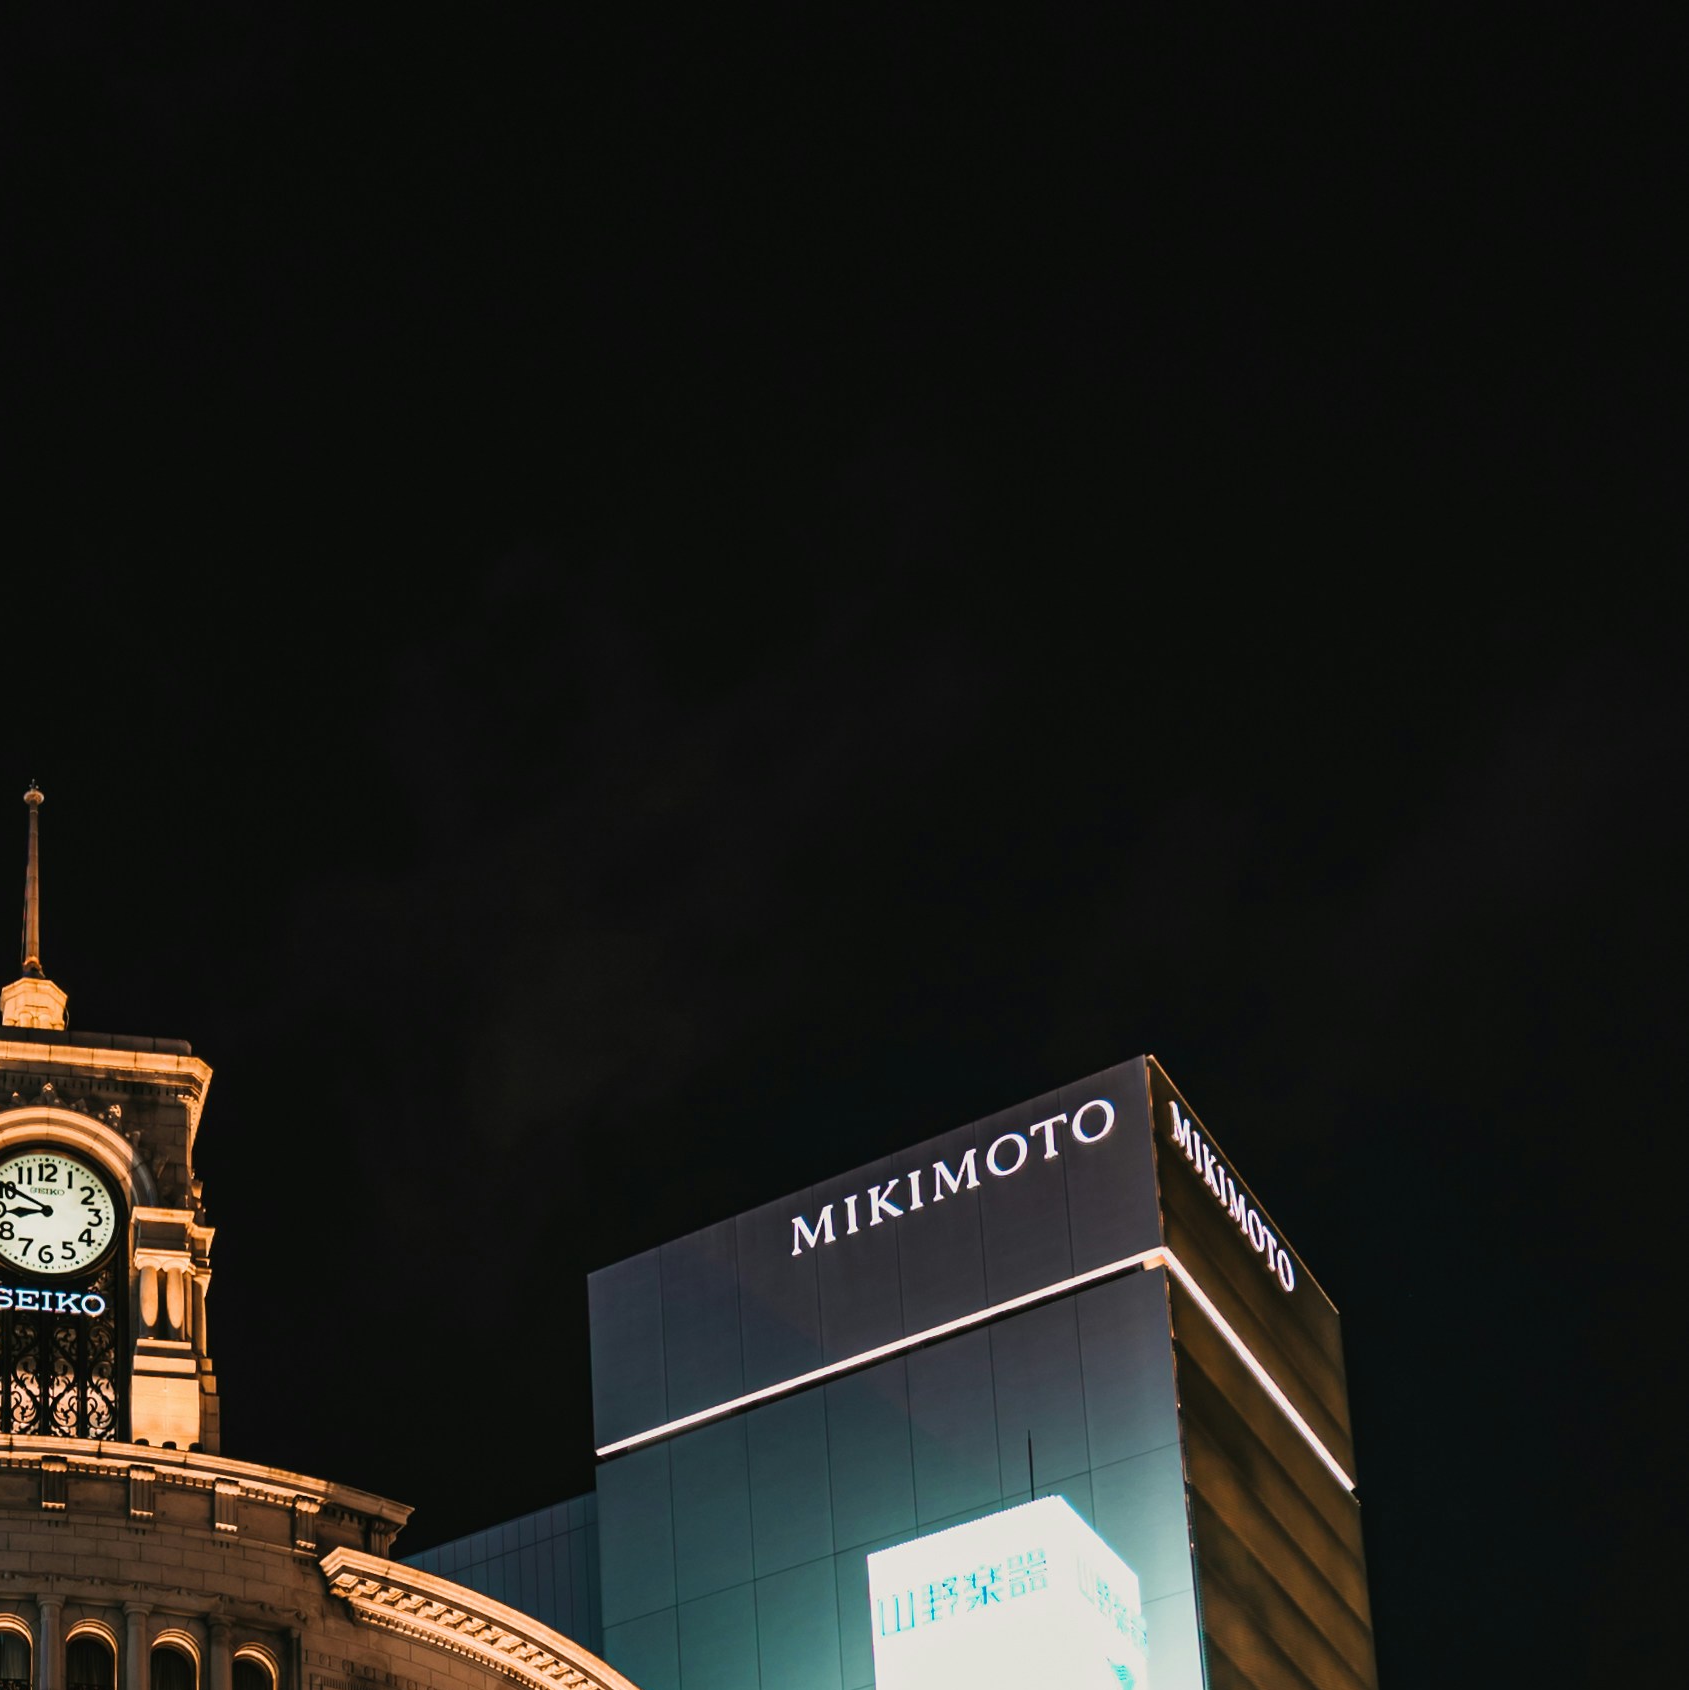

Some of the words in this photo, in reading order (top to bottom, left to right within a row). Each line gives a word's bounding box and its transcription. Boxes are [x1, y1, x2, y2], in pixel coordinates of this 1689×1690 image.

[17, 1166, 32, 1185] 11
[38, 1163, 58, 1182] 12
[67, 1171, 73, 1189] 1
[791, 1099, 1115, 1257] MIKIMOTO
[30, 1186, 65, 1196] SEIKO
[80, 1186, 95, 1205] 2
[1168, 1100, 1295, 1292] MIKIMOTO
[87, 1208, 103, 1227] 3
[18, 1238, 34, 1256] 7
[78, 1228, 95, 1247] 4
[38, 1245, 54, 1264] 6
[61, 1241, 76, 1260] 5
